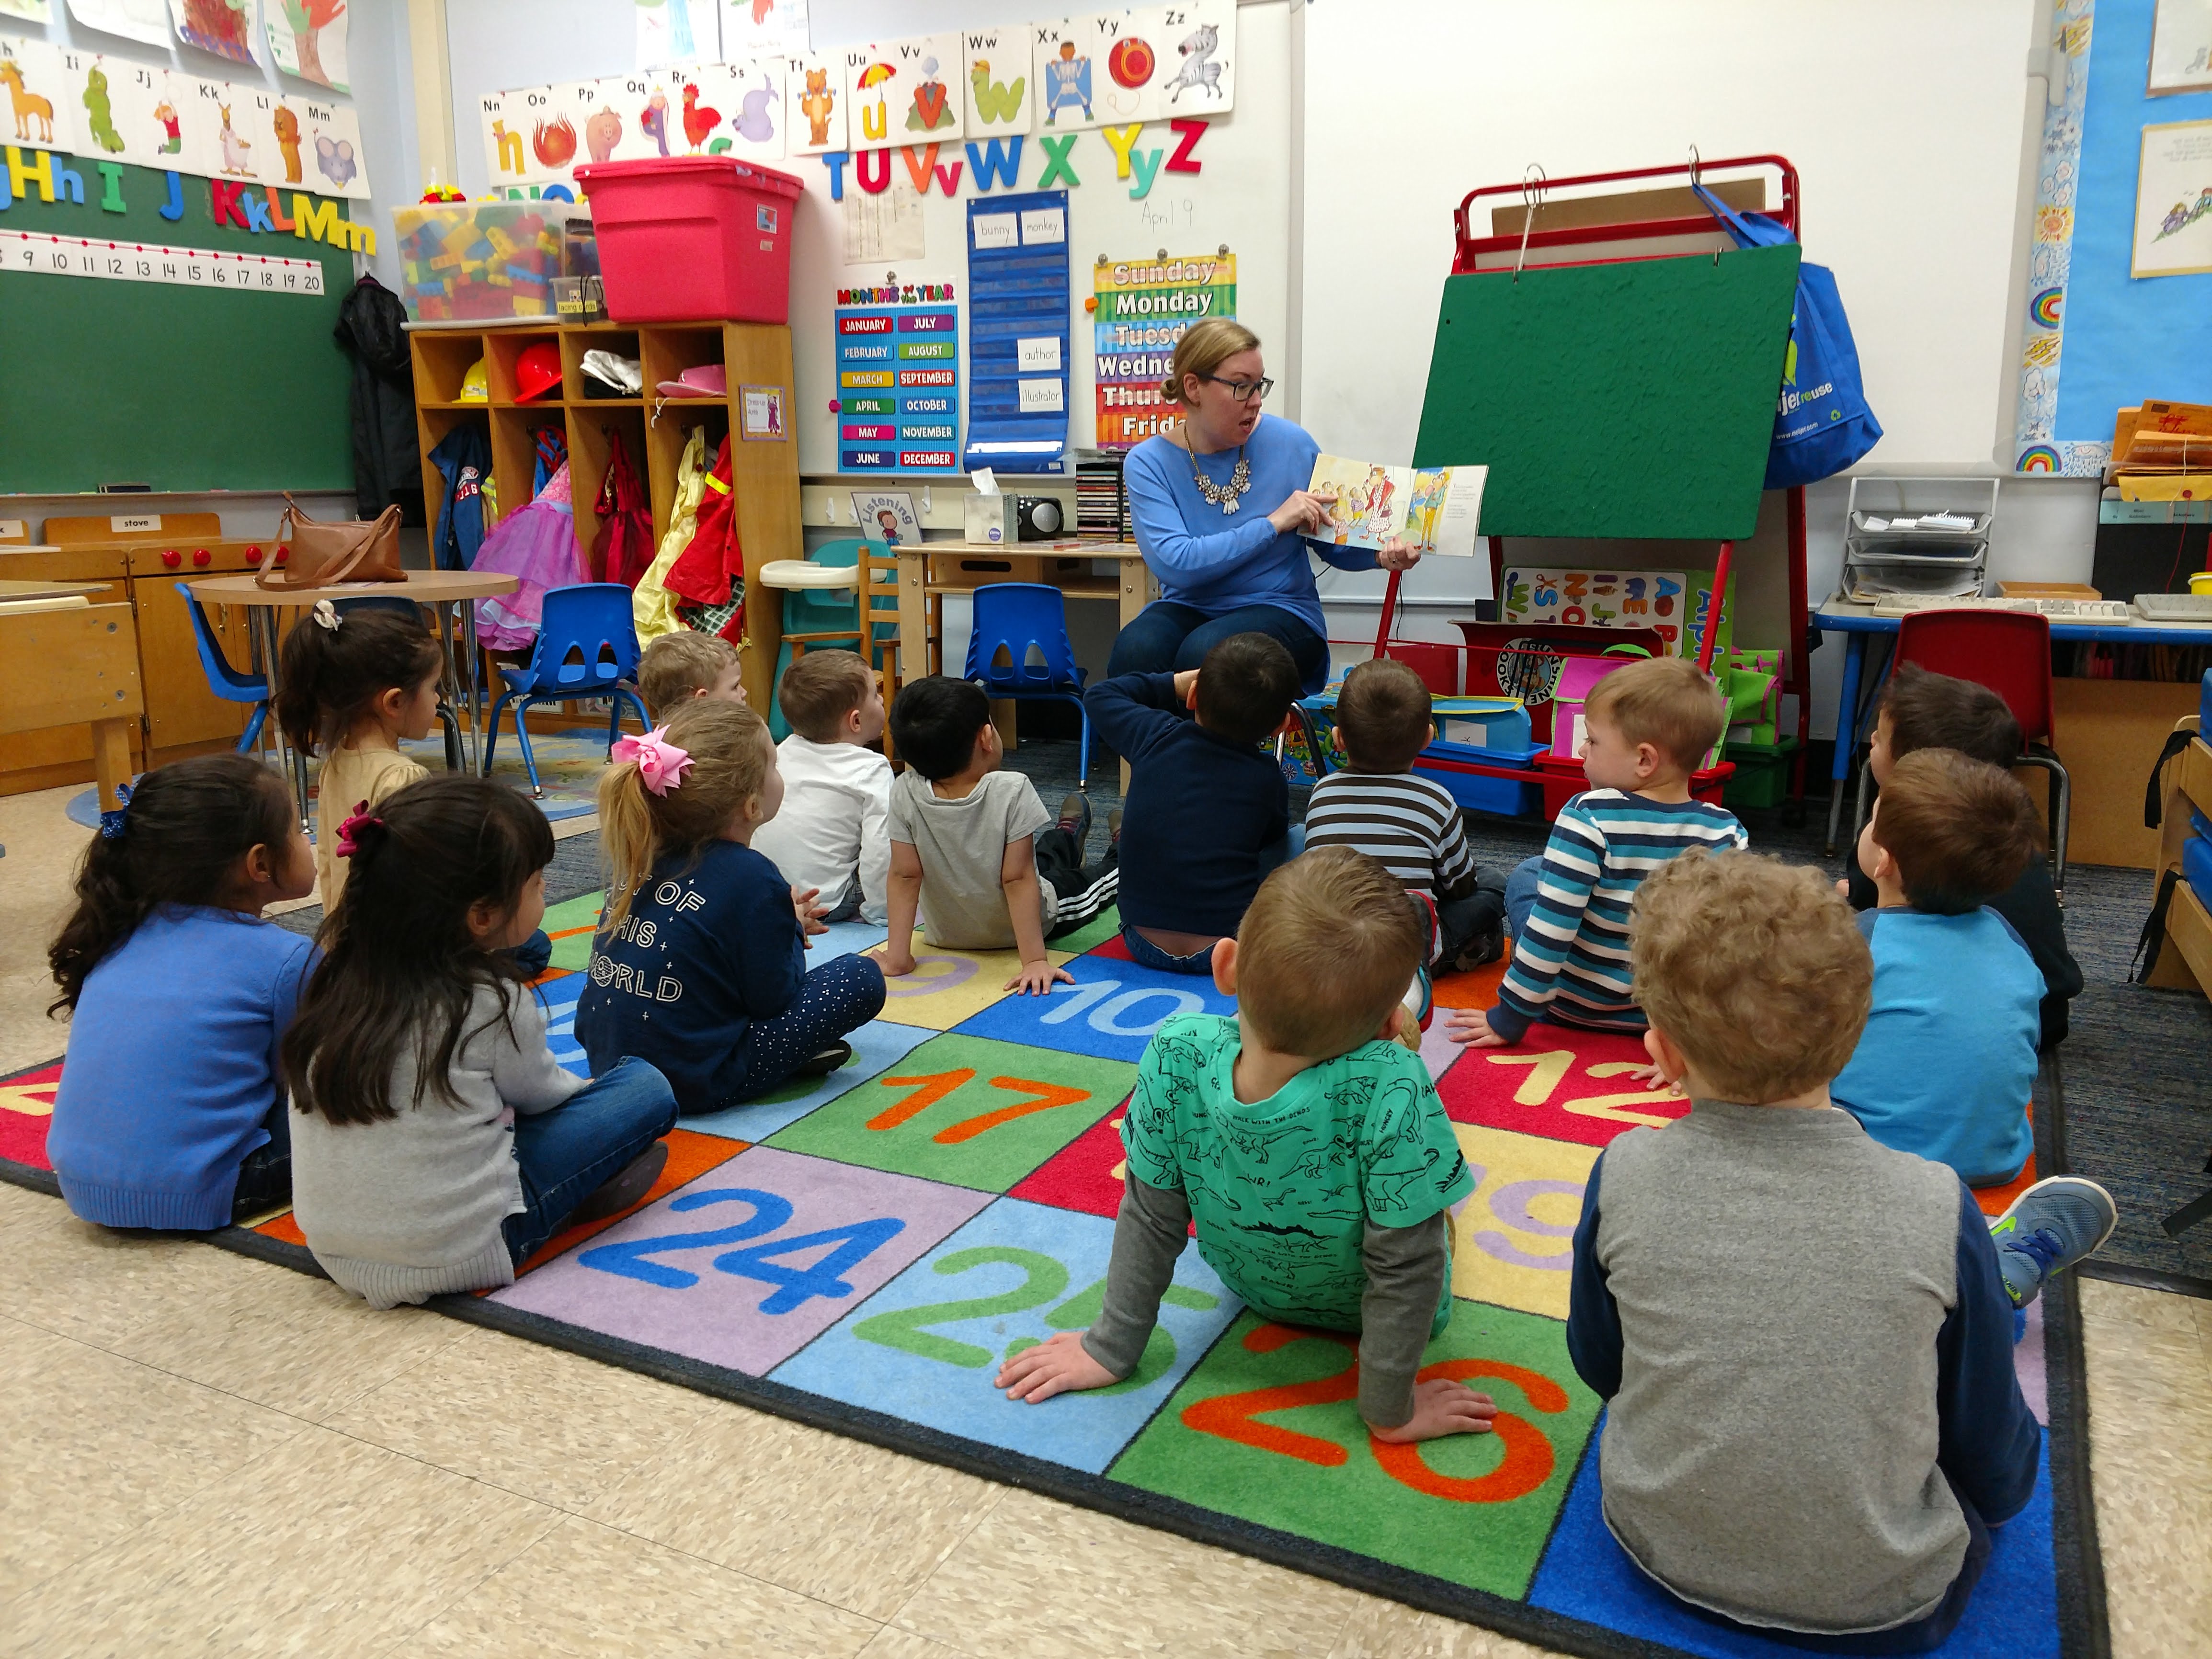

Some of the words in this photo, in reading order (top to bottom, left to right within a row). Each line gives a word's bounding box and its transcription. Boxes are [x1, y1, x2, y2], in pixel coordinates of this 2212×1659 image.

[484, 100, 500, 112] Nn
[528, 94, 546, 106] Oo
[579, 87, 593, 102] Pp
[627, 80, 646, 95] Qq
[673, 70, 687, 84] Rr
[730, 65, 744, 79] Ss
[789, 59, 803, 72] Tt
[848, 53, 866, 67] Uu
[901, 46, 920, 59] Vv
[969, 35, 997, 50] Ww
[1038, 28, 1059, 44] Xx
[1097, 18, 1119, 37] Yy
[1165, 9, 1185, 26] Zz
[66, 55, 79, 70] Ii
[137, 69, 151, 89] Jj
[199, 84, 219, 100] Kk
[257, 96, 269, 110] Ll
[308, 106, 331, 122] Mm
[1142, 201, 1174, 233] April
[1183, 199, 1193, 227] 9
[981, 218, 1010, 244] bunny
[1027, 216, 1058, 238] monkey
[23, 250, 33, 266] 9
[52, 253, 68, 269] 10
[83, 256, 94, 272] 11
[108, 259, 123, 274] 12
[137, 261, 150, 276] 13
[163, 262, 176, 278] 14
[188, 265, 201, 281] 15
[212, 267, 225, 283] 16
[237, 269, 250, 284] 17
[261, 271, 273, 286] 18
[284, 273, 295, 288] 19
[304, 276, 319, 290] 20
[1114, 261, 1216, 285] Sunday
[837, 286, 899, 305] MONTHS
[901, 293, 917, 304] the
[916, 284, 955, 302] YEAR
[1116, 290, 1212, 316] Monday
[558, 303, 577, 313] lacing
[579, 302, 596, 311] crds
[845, 318, 886, 332] JANUARY
[913, 316, 936, 329] JULY
[844, 347, 887, 358] FEBRUARY
[909, 345, 943, 356] AUGUST
[1025, 348, 1056, 361] author
[852, 374, 883, 385] MARCH
[901, 372, 952, 384] SEPTEMBER
[856, 400, 881, 412] APRIL
[907, 399, 946, 411] OCTOBER
[1022, 387, 1060, 404] illustrator
[859, 427, 878, 438] MAY
[902, 426, 952, 438] NOVEMBER
[856, 453, 880, 464] JUNE
[904, 453, 950, 465] DECEMBER
[863, 498, 913, 525] Listening
[655, 881, 707, 912] OF
[1040, 979, 1205, 1037] 10
[865, 1067, 1093, 1145] 17
[1379, 1108, 1393, 1134] HUNGRY
[576, 1188, 906, 1316] 24
[1181, 1323, 1570, 1503] 26
